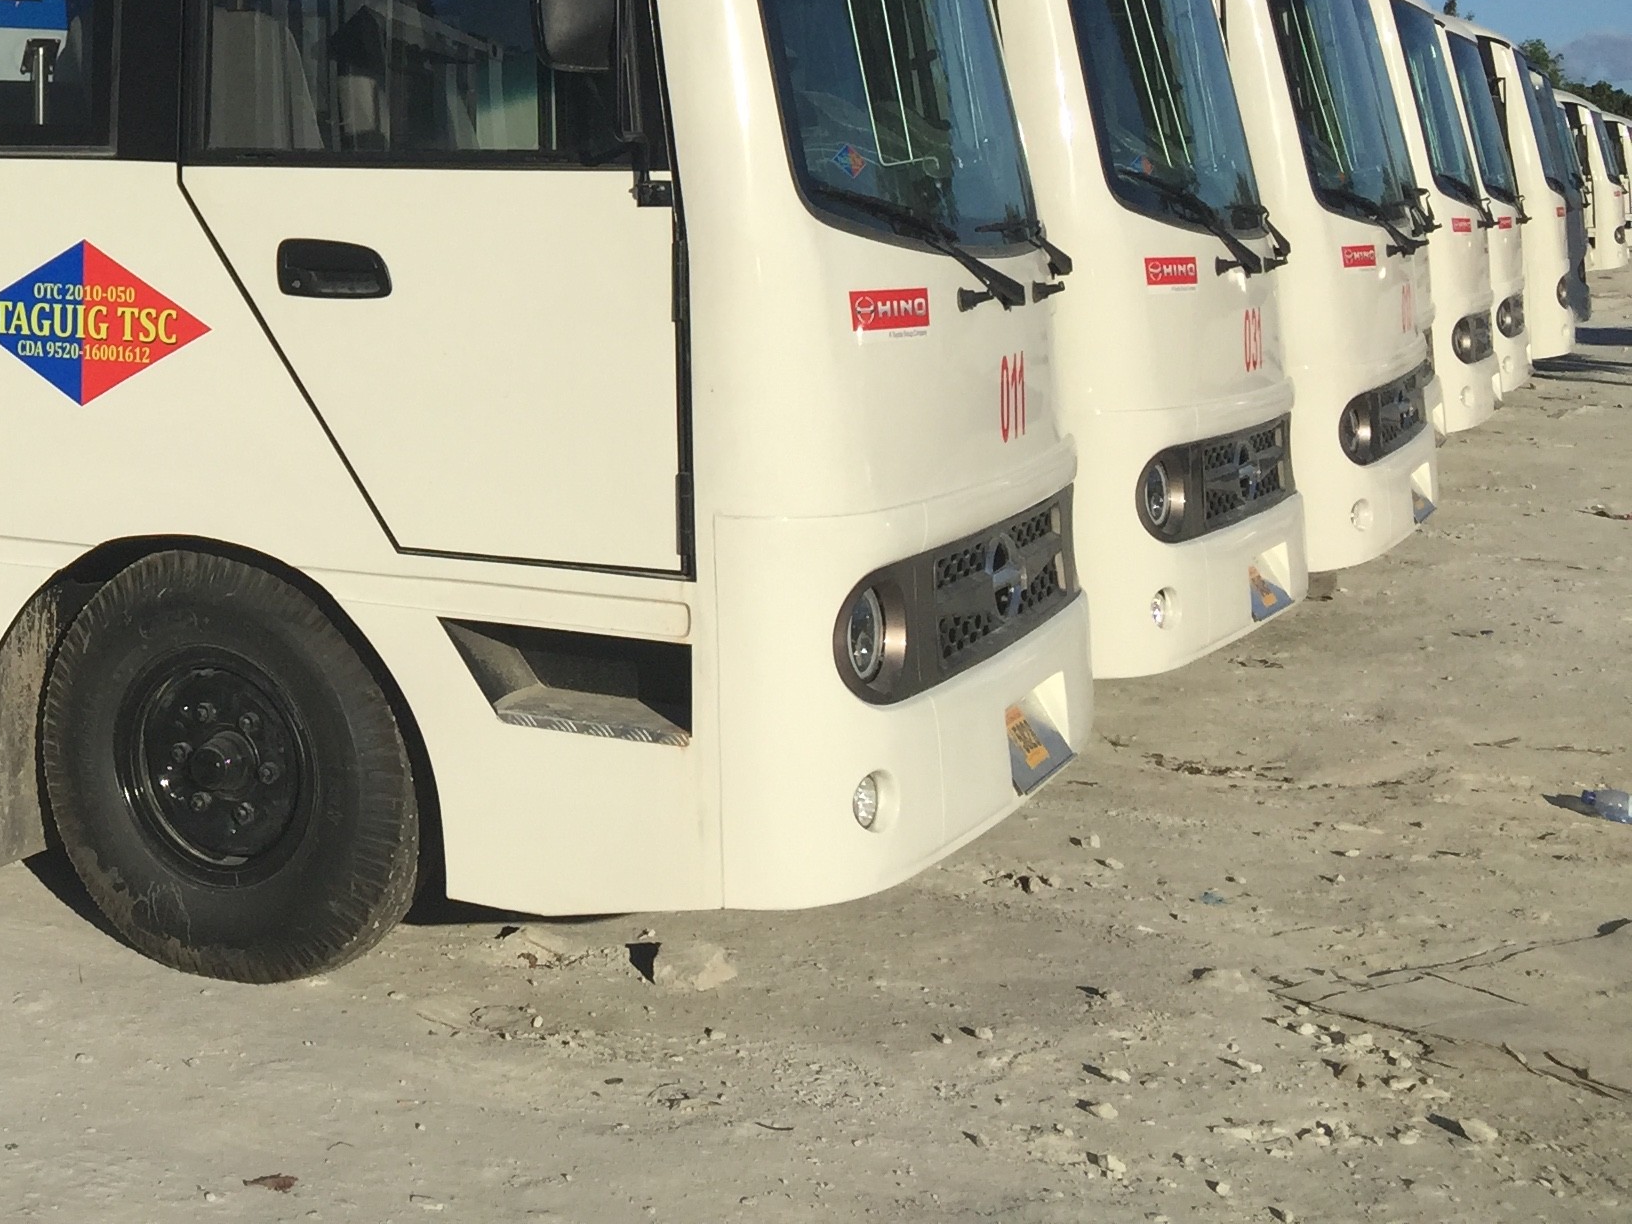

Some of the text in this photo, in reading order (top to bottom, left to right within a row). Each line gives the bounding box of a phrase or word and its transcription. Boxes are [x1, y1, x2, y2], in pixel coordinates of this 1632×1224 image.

[1162, 263, 1196, 277] HINO
[33, 282, 136, 303] OTC 2010-050
[876, 297, 927, 318] HINO
[116, 307, 178, 345] TSC
[17, 339, 151, 364] CDA 9520-16001612
[1244, 306, 1263, 373] 031
[1000, 350, 1026, 444] 011
